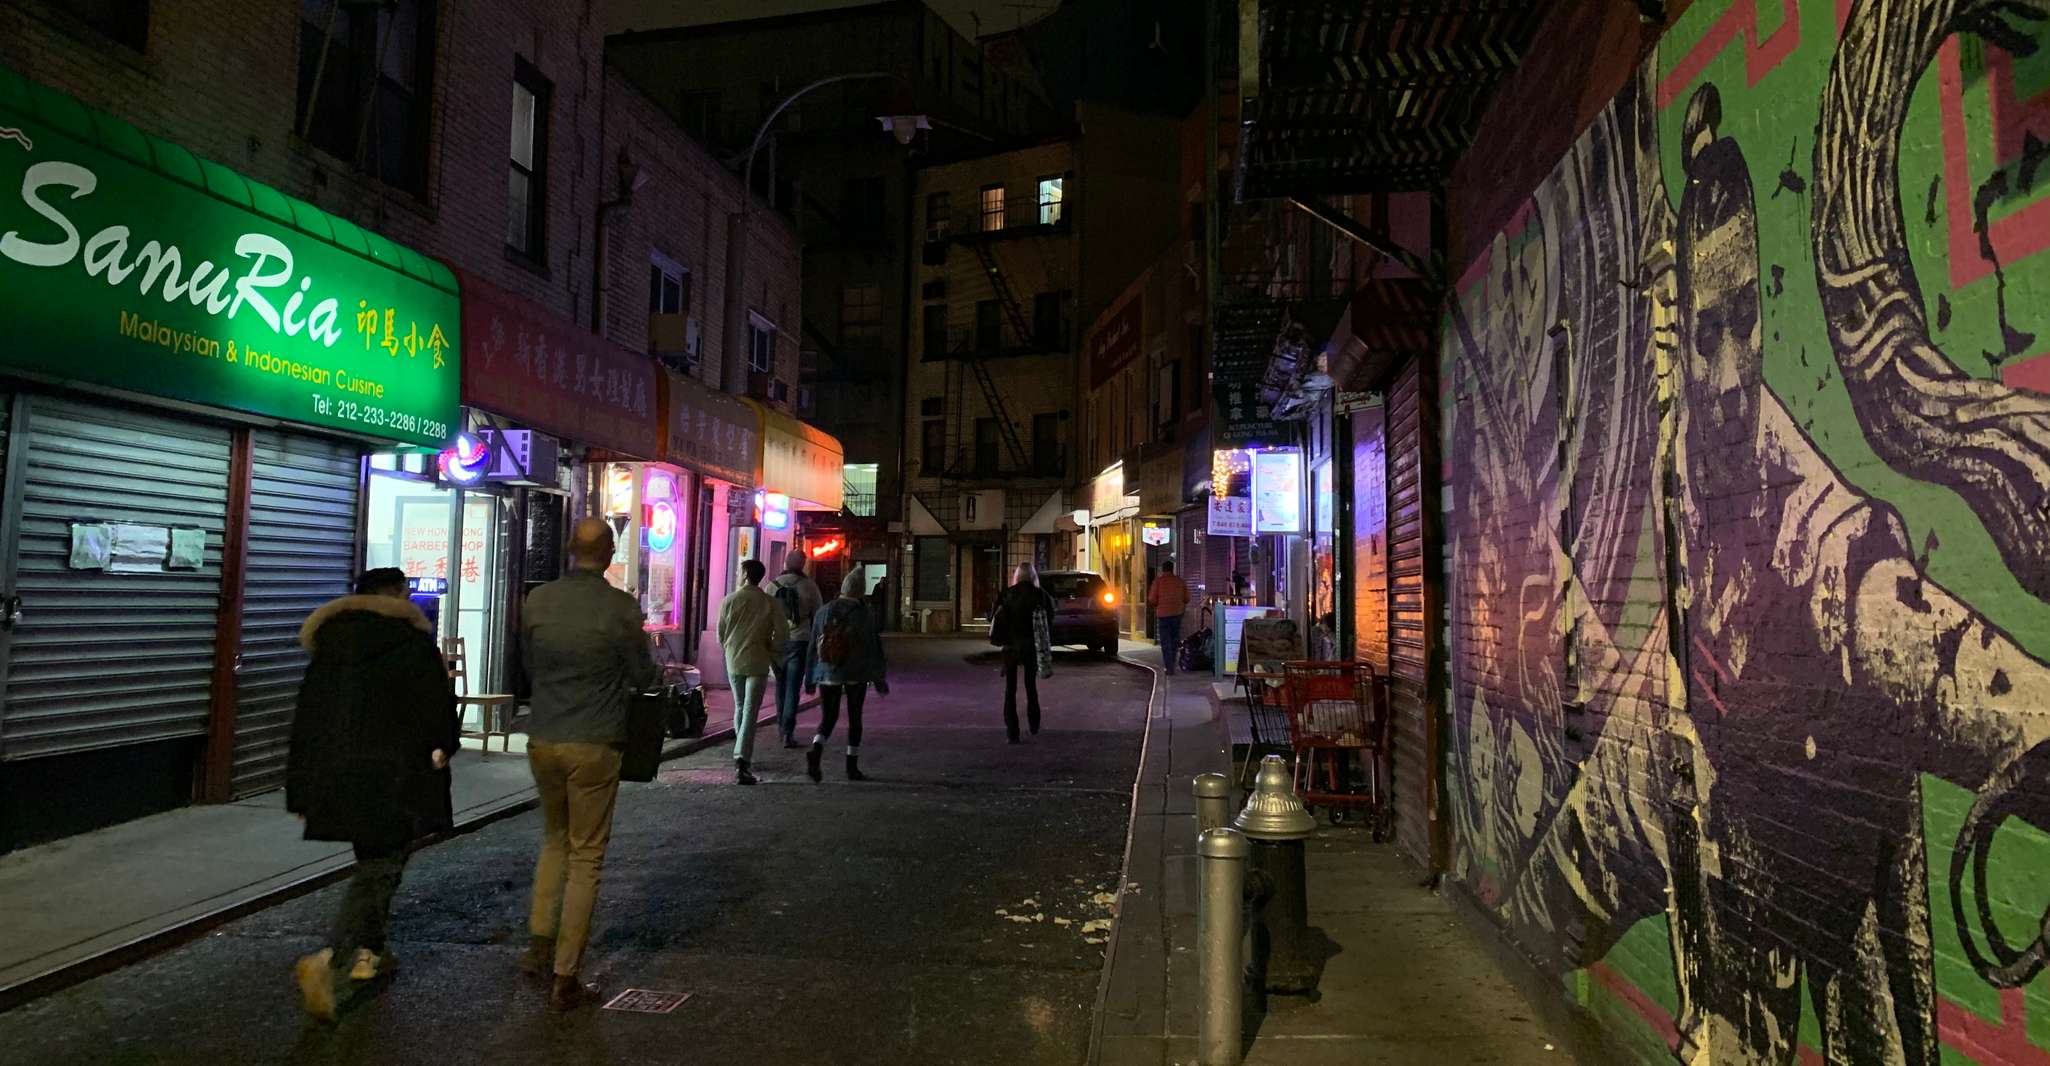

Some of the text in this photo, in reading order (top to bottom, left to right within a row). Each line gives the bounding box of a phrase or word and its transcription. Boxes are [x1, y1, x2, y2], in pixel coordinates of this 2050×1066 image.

[119, 310, 385, 399] Malaysian & Indonesian Cuisine
[312, 393, 333, 417] Tel:
[428, 527, 448, 537] HON
[463, 527, 483, 537] ONG
[461, 540, 483, 551] HOP
[417, 577, 438, 592] ATM
